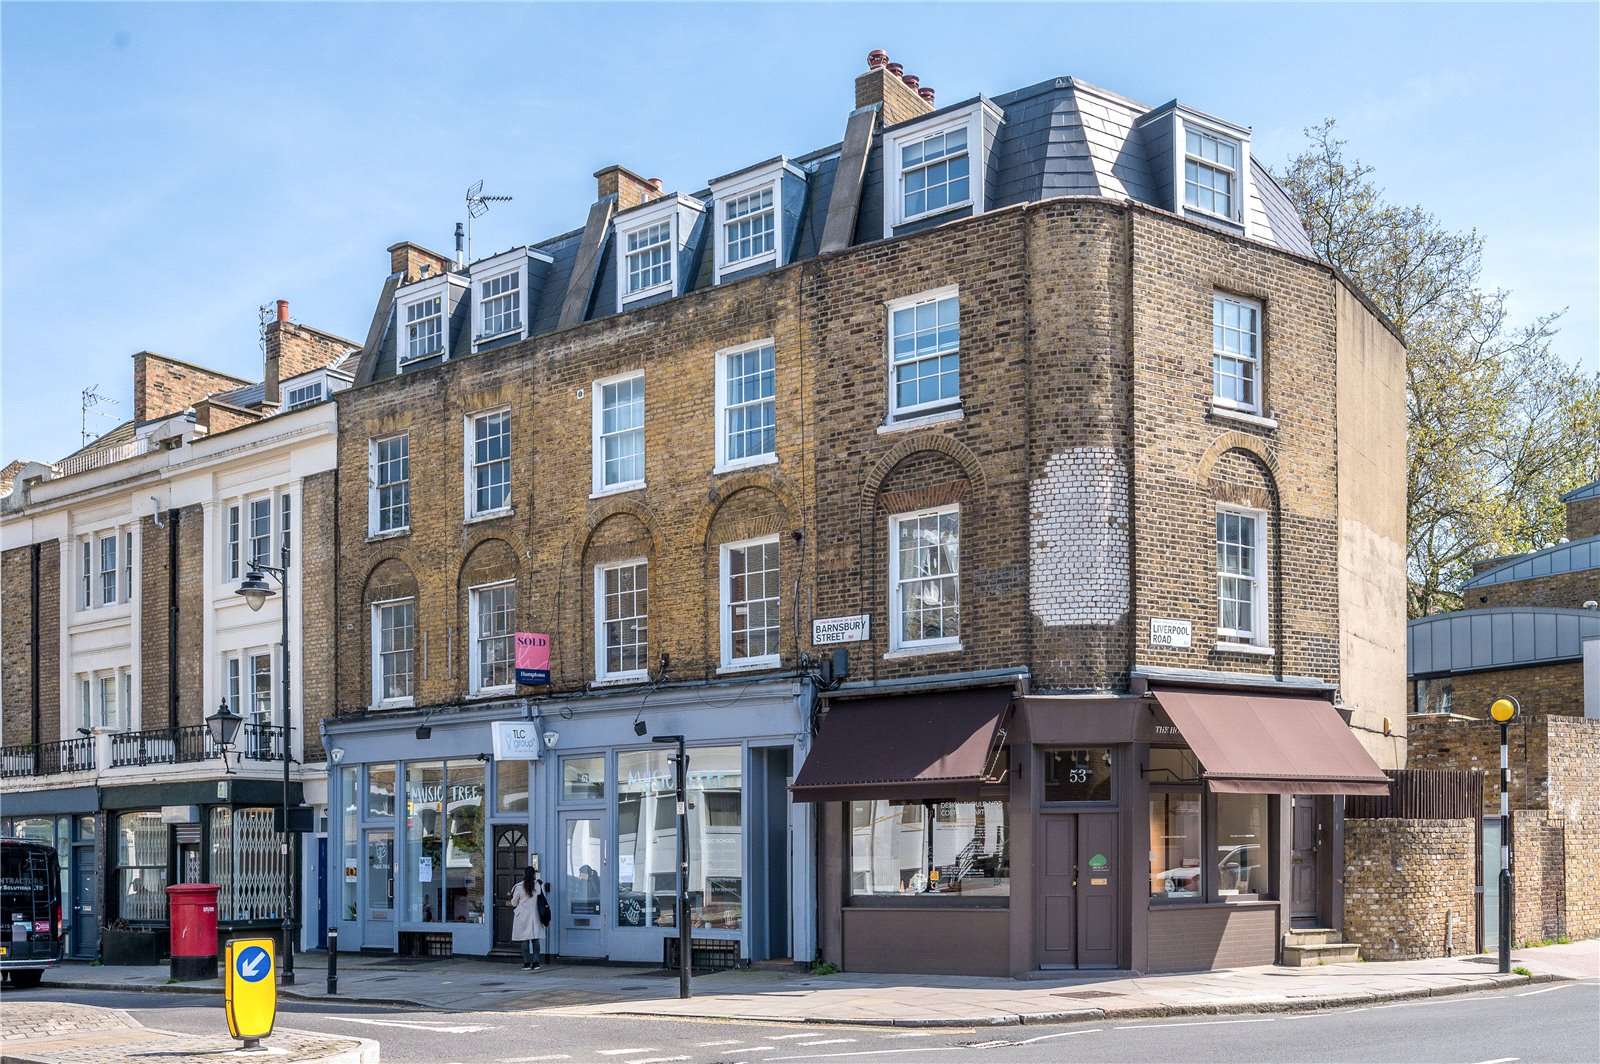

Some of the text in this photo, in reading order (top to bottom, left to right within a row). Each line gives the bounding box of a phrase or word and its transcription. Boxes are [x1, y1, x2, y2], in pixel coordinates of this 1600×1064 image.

[815, 621, 866, 634] BARNSBURY
[1152, 624, 1190, 636] LIVERPOOL
[517, 638, 546, 647] SOLD
[815, 632, 846, 643] STREET
[1152, 634, 1172, 644] ROAD
[512, 729, 526, 739] TLC
[1069, 769, 1087, 783] 53
[410, 784, 480, 804] MUSIC TREE
